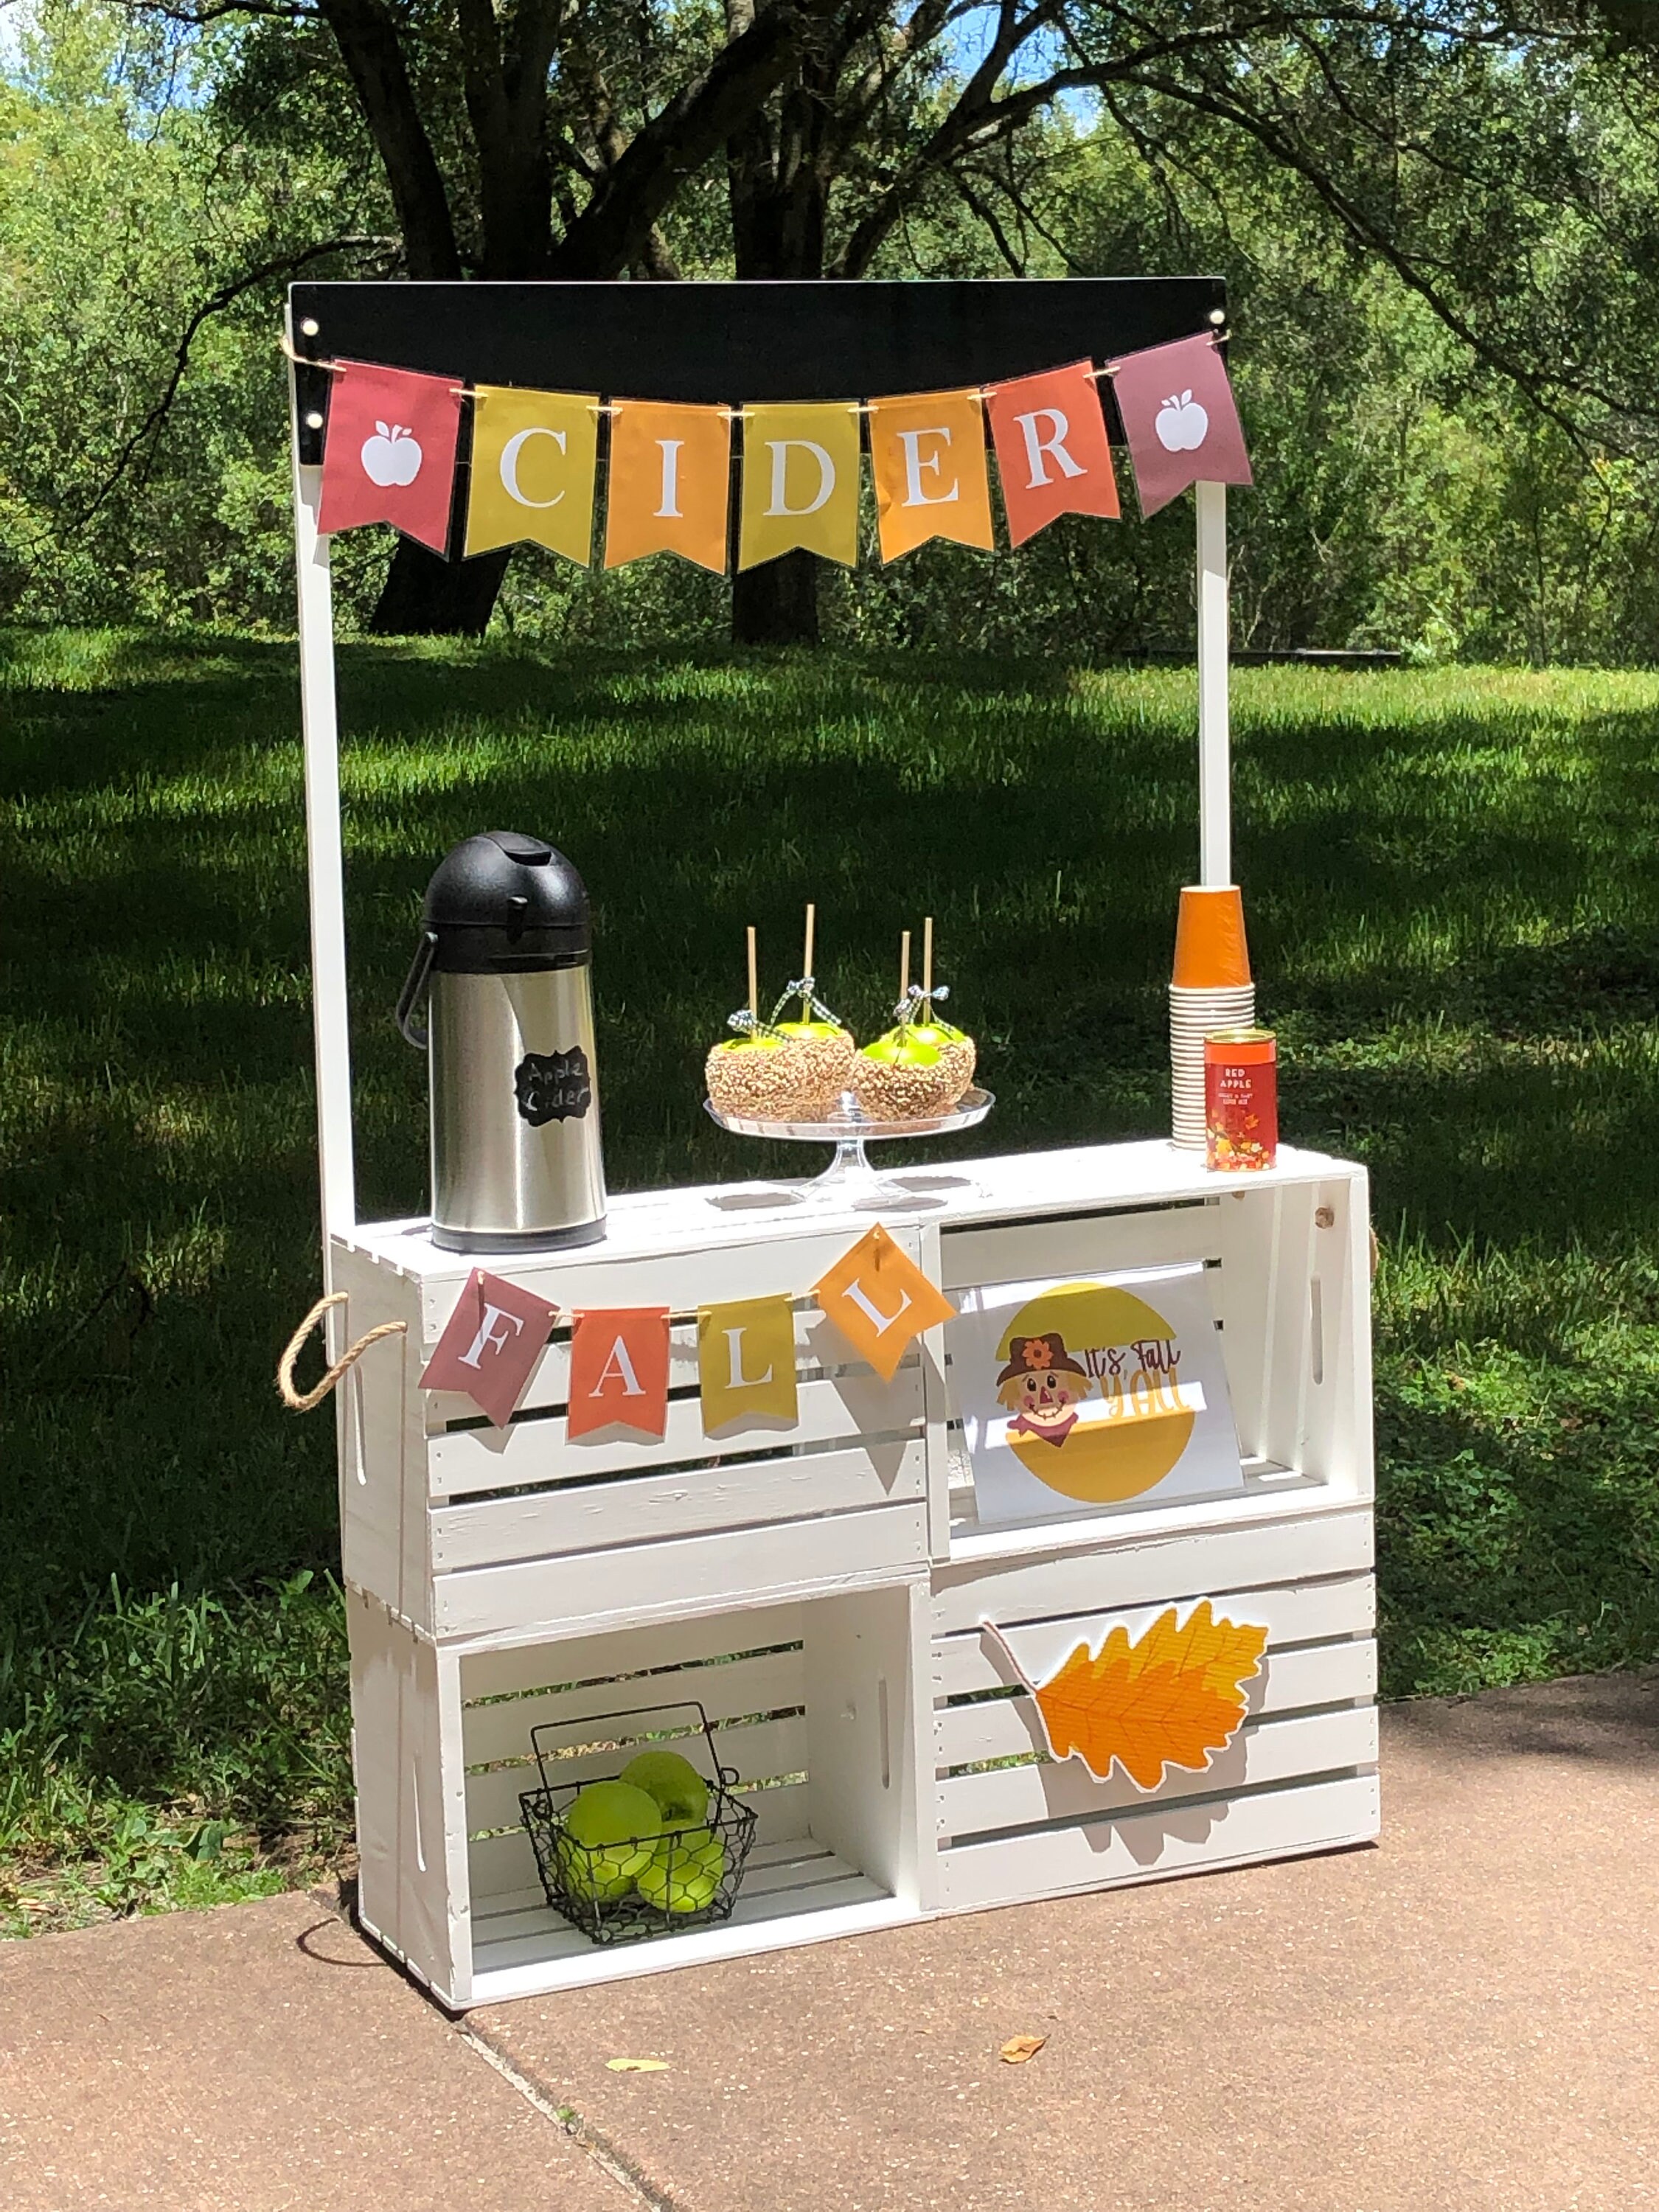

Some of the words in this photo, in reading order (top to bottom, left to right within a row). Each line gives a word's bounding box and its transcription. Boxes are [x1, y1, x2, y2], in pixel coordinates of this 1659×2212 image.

[499, 408, 1088, 518] CIDER
[529, 1060, 584, 1085] Apple
[1220, 1079, 1252, 1089] APPLE
[1225, 1068, 1245, 1077] RED
[457, 1278, 913, 1397] FALL
